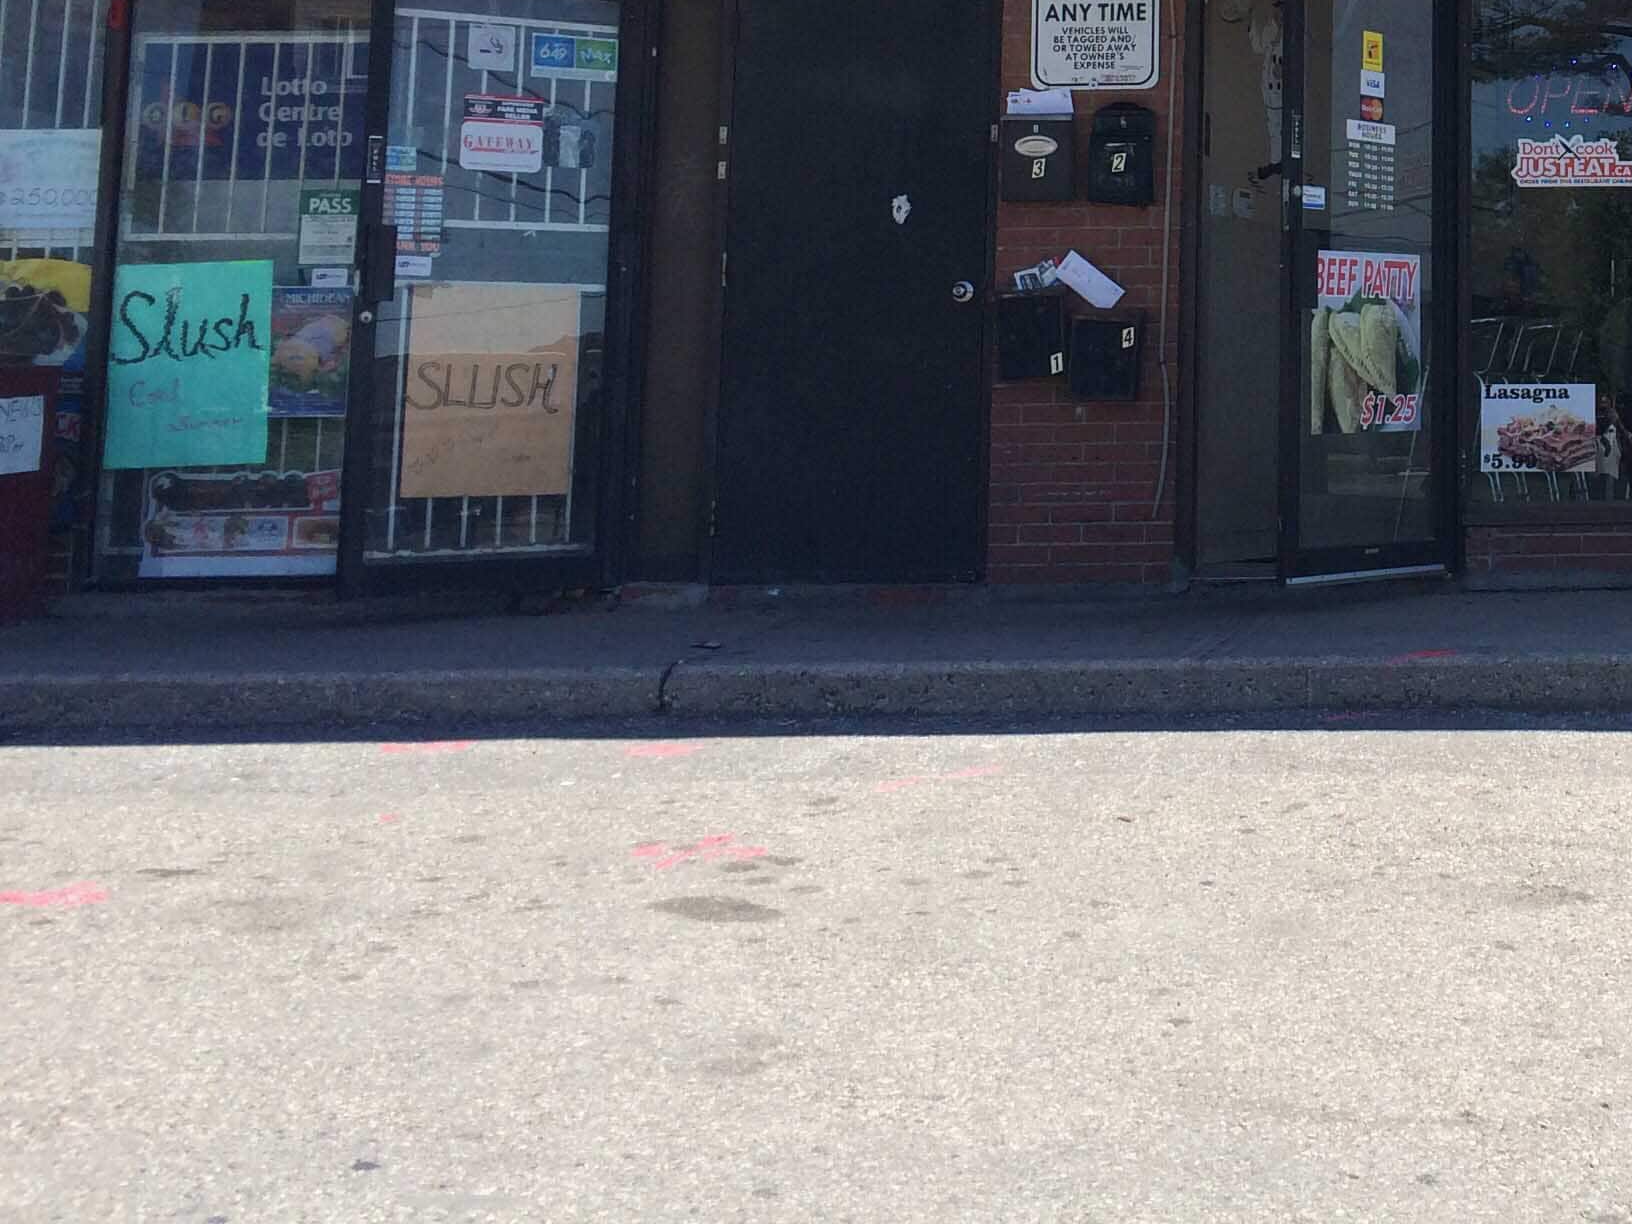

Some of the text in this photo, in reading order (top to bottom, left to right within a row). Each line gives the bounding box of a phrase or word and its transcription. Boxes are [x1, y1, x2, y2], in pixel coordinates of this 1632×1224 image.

[1045, 2, 1147, 22] ANY TIME
[1053, 36, 1066, 45] BE
[1067, 35, 1107, 44] TAGGED
[1061, 26, 1129, 36] VEHICLES WILL
[1052, 44, 1137, 53] OR TOWED AWAY
[1065, 52, 1125, 62] AT OWNER'S
[1074, 61, 1116, 70] EXPENSE
[261, 77, 328, 96] Lotto
[258, 102, 343, 122] Centre
[1576, 141, 1613, 156] cook
[1033, 159, 1044, 178] 3
[1114, 154, 1125, 172] 2
[310, 198, 352, 214] PASS
[1317, 257, 1419, 302] BEEF PATTY
[111, 287, 264, 366] Slush
[1123, 328, 1134, 347] 4
[1053, 353, 1062, 373] 1
[405, 361, 559, 414] SLUSH
[1485, 384, 1570, 404] Lasagna
[1361, 391, 1417, 428] $1.25
